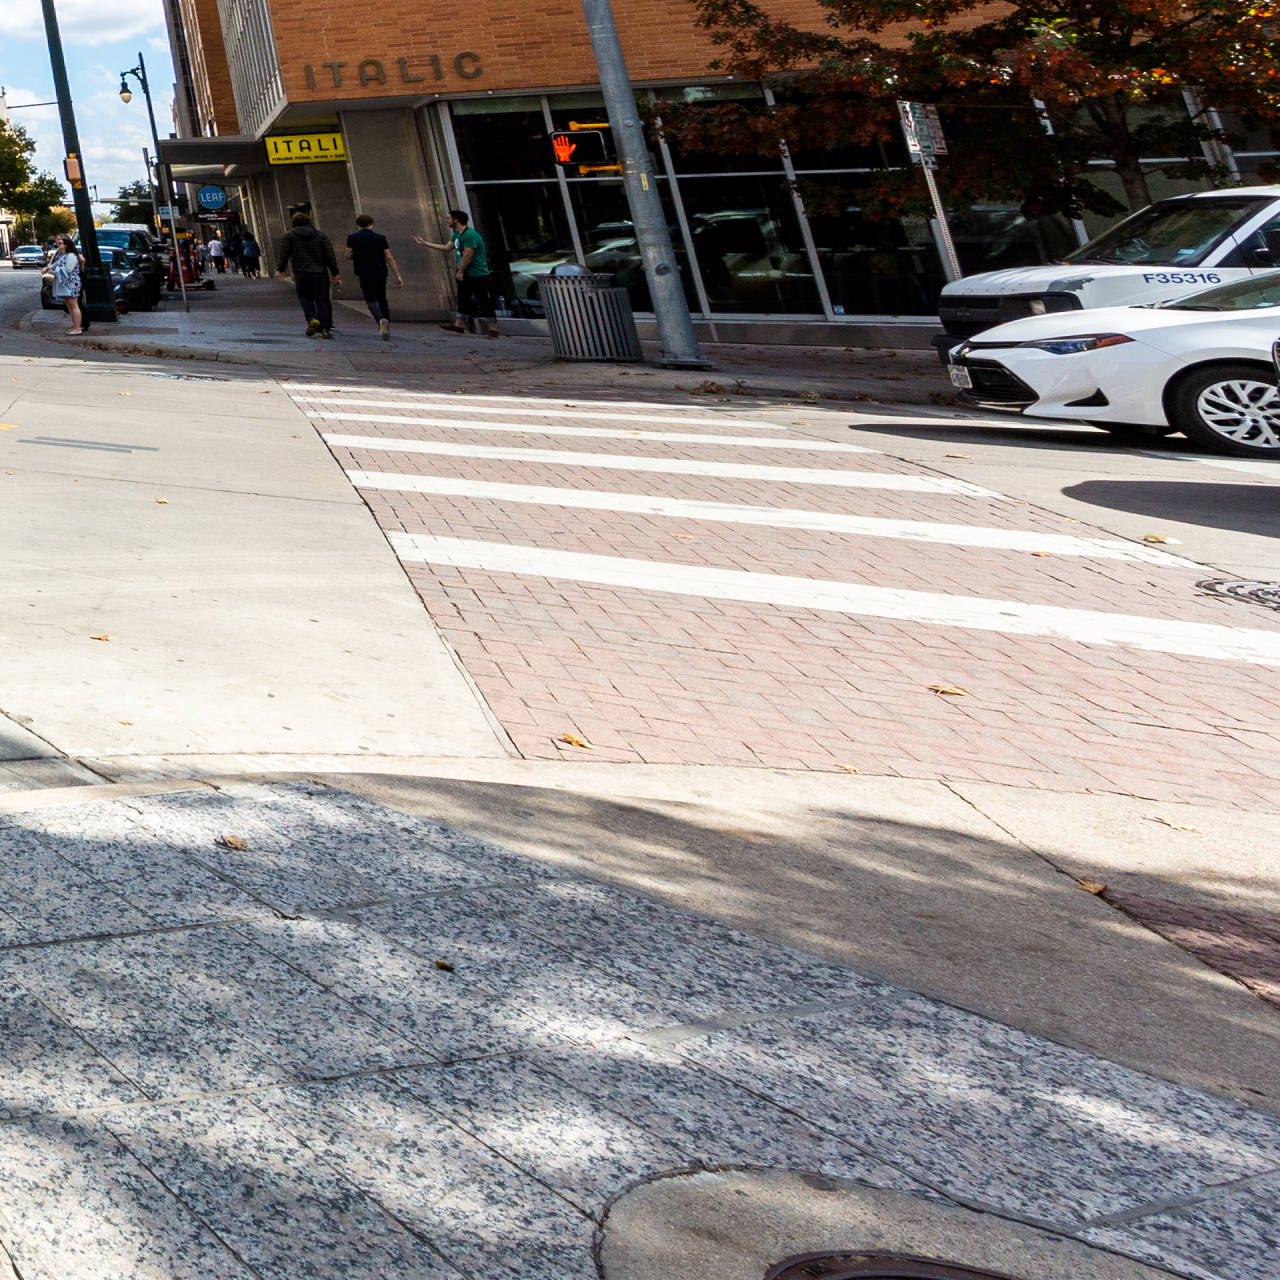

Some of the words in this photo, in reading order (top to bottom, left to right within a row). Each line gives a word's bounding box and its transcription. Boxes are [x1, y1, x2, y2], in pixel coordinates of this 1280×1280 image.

[303, 51, 483, 89] ITALIC
[199, 192, 224, 202] LEAF
[1143, 272, 1221, 285] F35316
